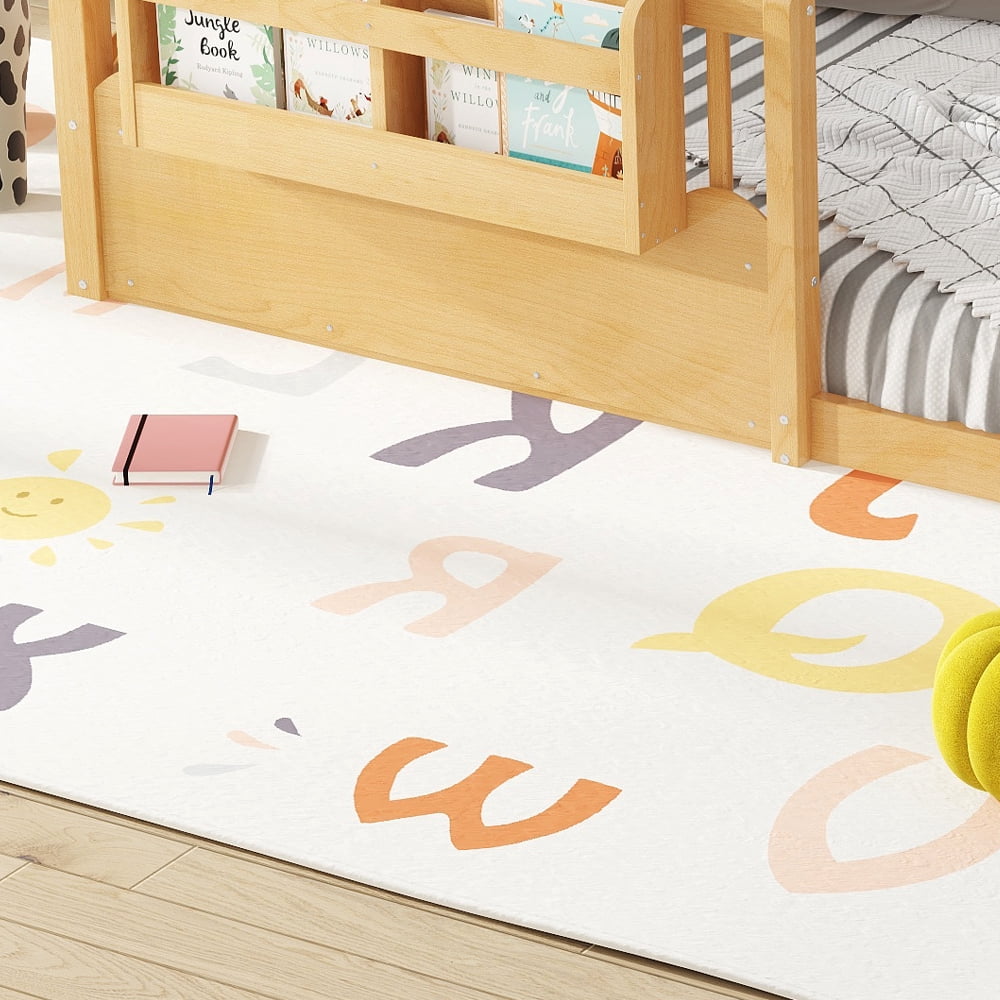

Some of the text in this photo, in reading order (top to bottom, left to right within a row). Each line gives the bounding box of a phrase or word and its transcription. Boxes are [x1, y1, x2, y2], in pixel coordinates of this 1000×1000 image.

[184, 9, 240, 40] Jungle
[306, 37, 369, 60] WILLOWS
[462, 64, 497, 82] WIN
[450, 89, 498, 108] WILLO
